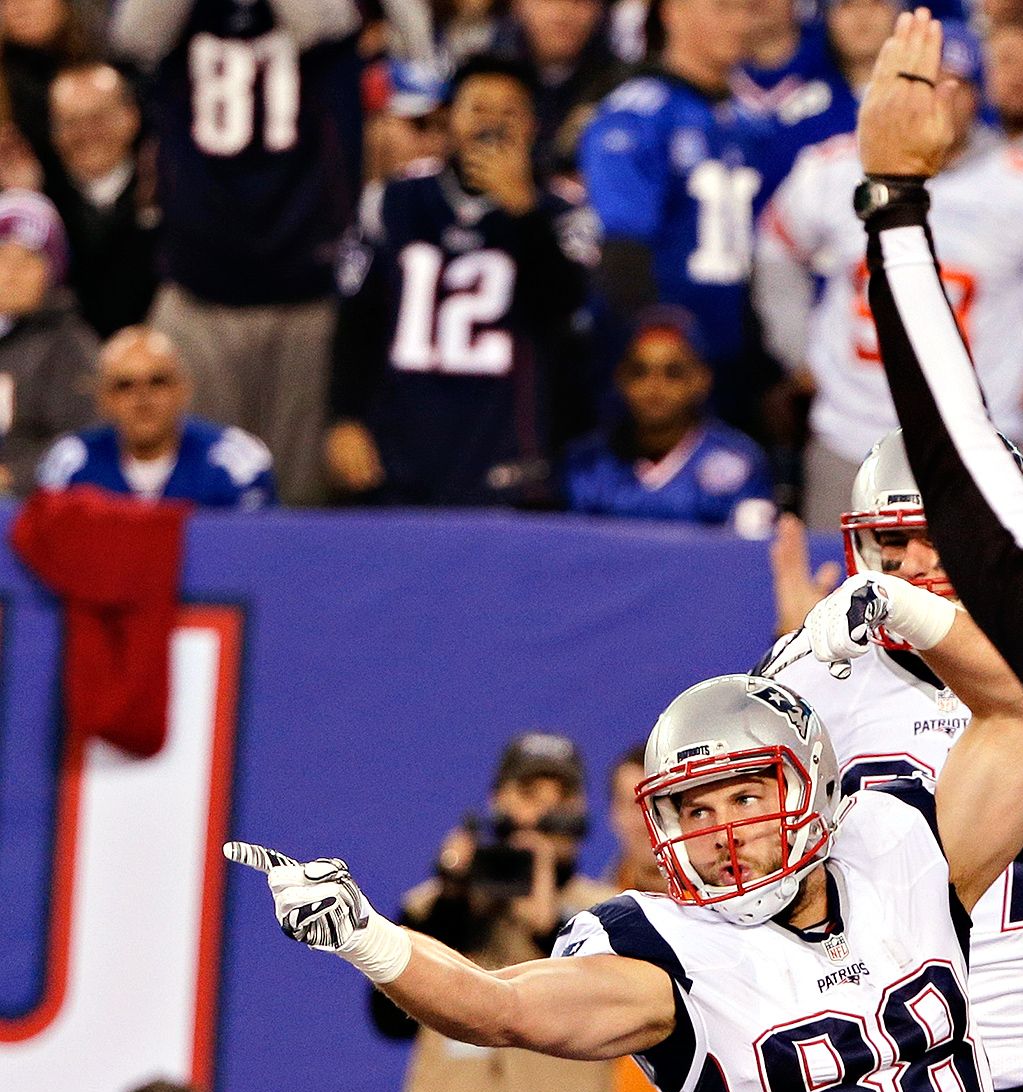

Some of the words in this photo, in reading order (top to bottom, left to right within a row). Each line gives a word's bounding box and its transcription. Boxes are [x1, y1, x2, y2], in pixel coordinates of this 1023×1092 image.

[390, 242, 516, 374] 12
[914, 718, 969, 735] PATRIOT
[829, 944, 849, 959] NFL
[817, 962, 870, 993] PATRIOS
